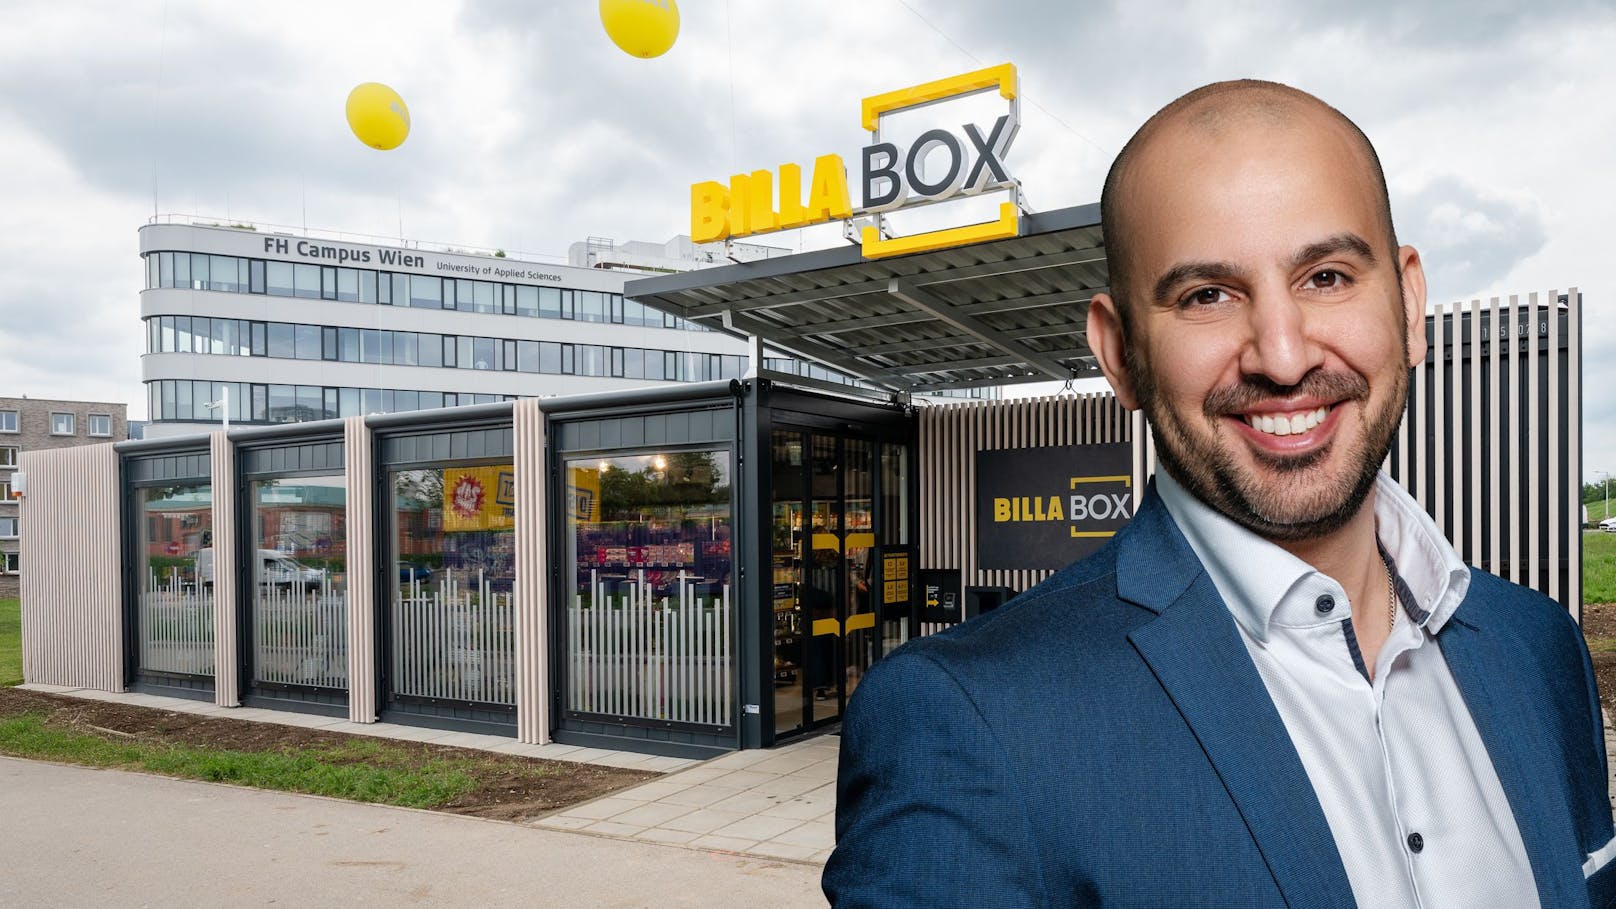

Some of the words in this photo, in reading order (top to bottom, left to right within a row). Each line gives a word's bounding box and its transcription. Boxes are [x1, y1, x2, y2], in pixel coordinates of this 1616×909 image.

[691, 153, 853, 244] BILLA
[862, 114, 1016, 212] BOX
[264, 236, 289, 255] FH
[296, 238, 372, 266] Campus
[378, 248, 424, 270] Wien
[436, 261, 480, 276] University
[482, 266, 492, 275] of
[494, 267, 525, 280] Applied
[527, 271, 562, 283] Sciences
[993, 496, 1064, 523] BILLA
[1070, 493, 1131, 521] BOX
